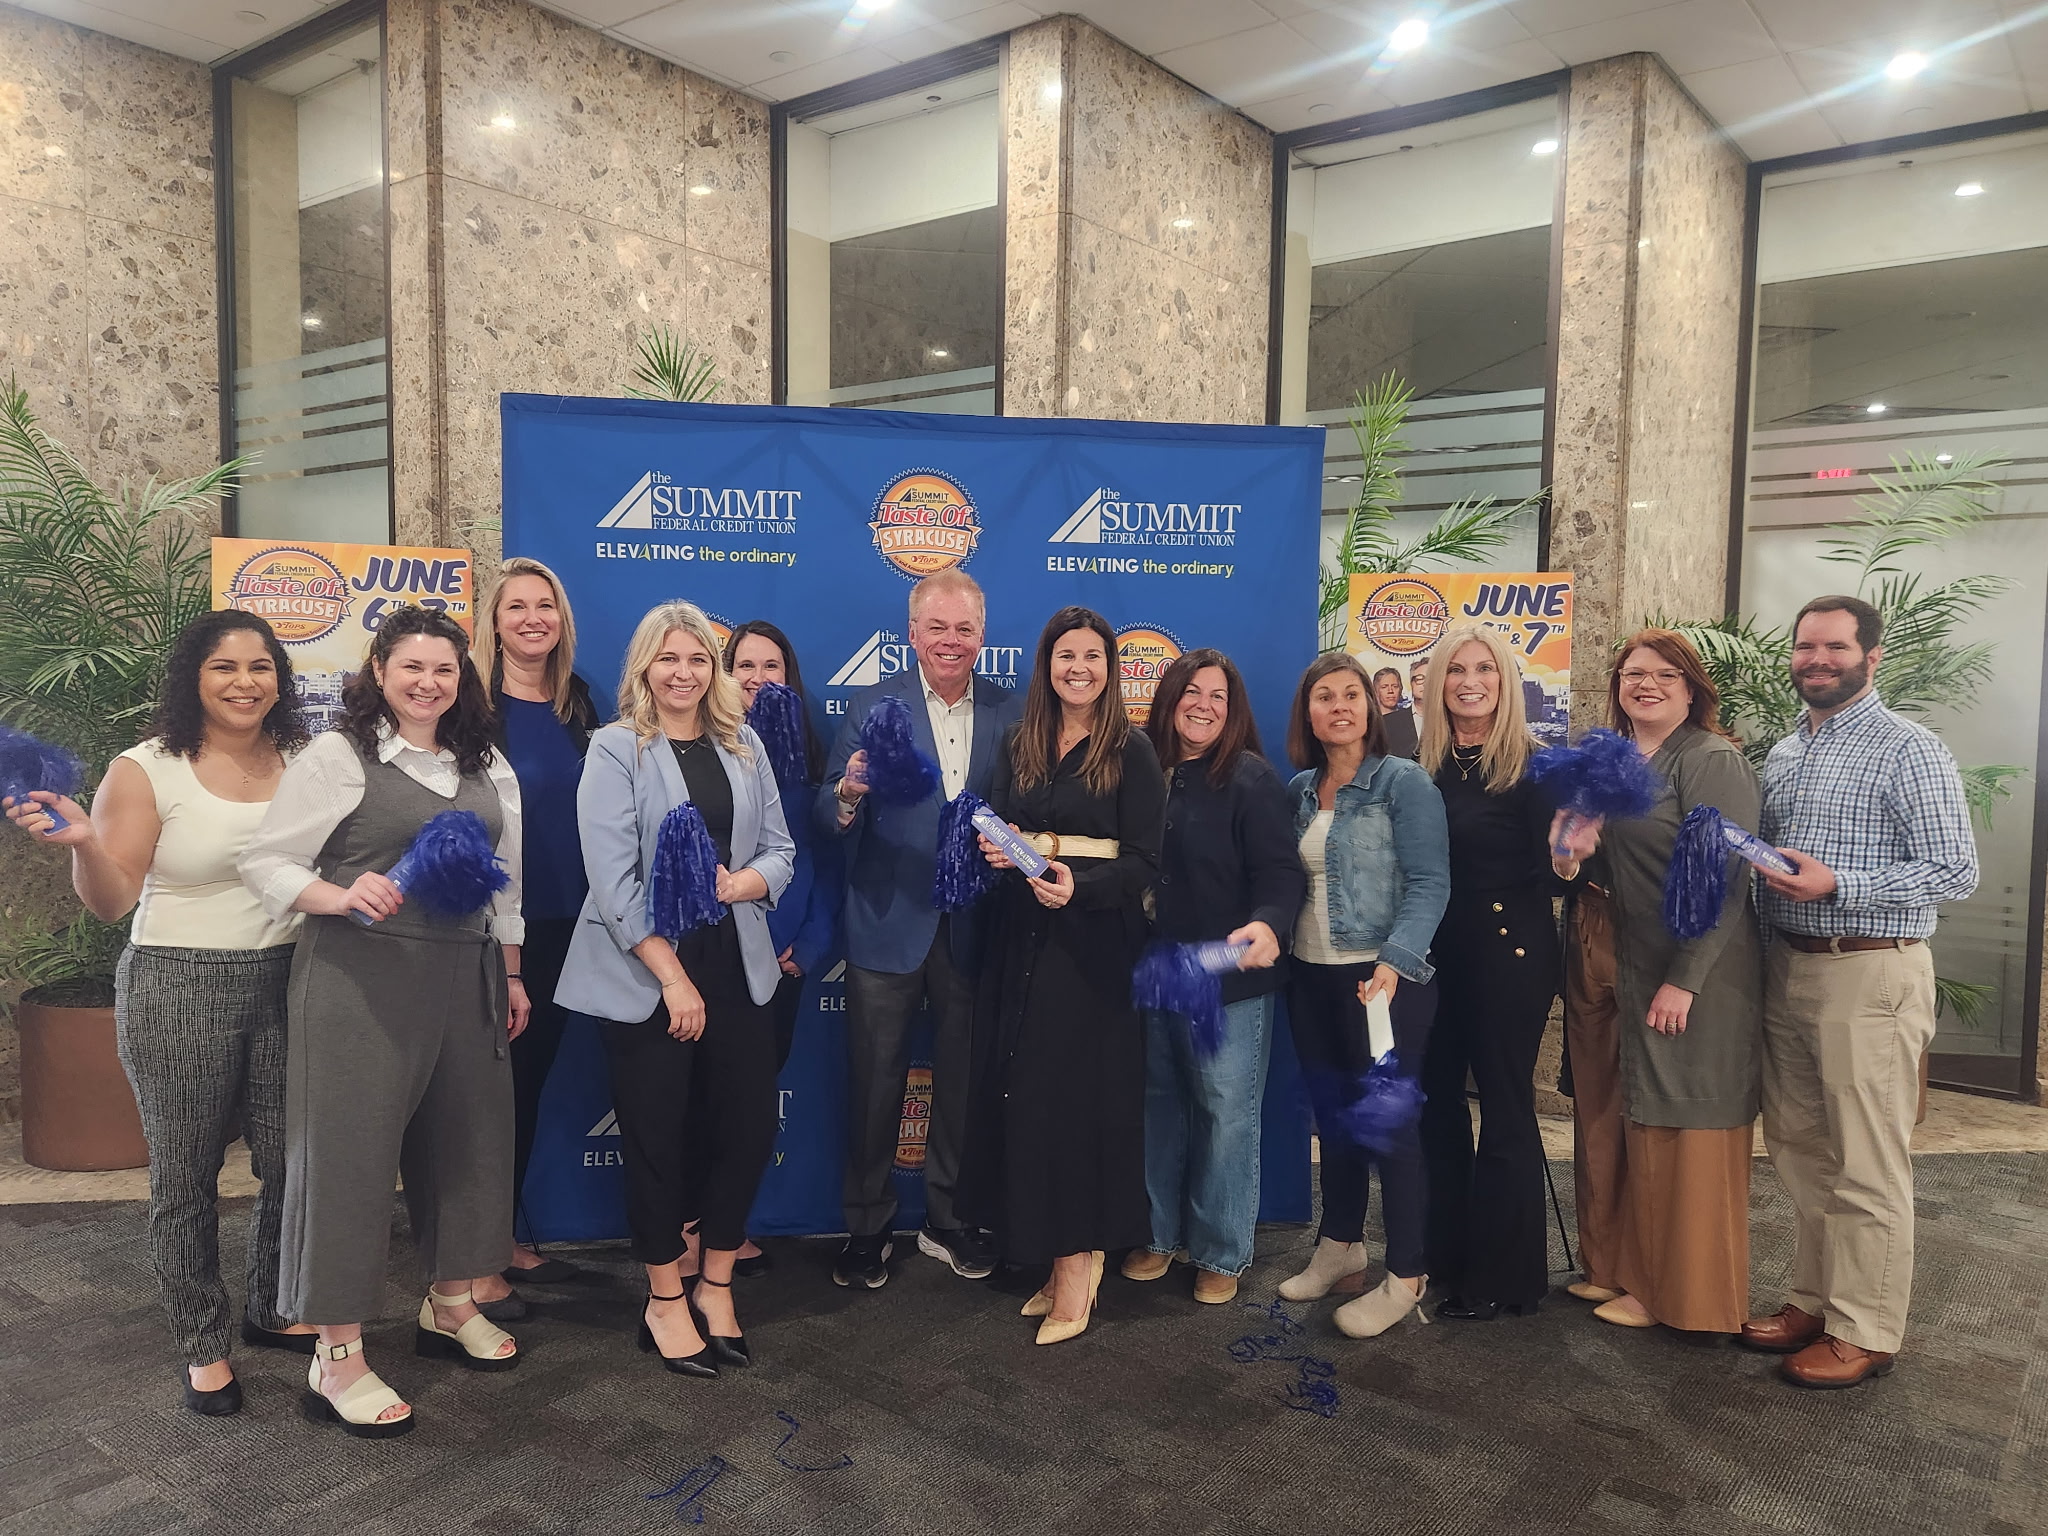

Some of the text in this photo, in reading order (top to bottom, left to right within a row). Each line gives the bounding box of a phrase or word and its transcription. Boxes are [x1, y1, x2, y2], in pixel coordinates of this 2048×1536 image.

[652, 471, 671, 484] the
[652, 485, 801, 520] SUMMIT
[912, 492, 949, 500] SUMMIT
[1102, 488, 1120, 500] the
[881, 503, 974, 527] Taste Of
[1101, 502, 1242, 533] SUMMIT
[653, 518, 796, 534] FEDERAL CREDIT UNION
[883, 529, 966, 551] SYRACUSE
[1101, 532, 1235, 546] FEDERAL CREDIT UNION
[596, 542, 694, 561] ELEVATING
[699, 546, 725, 561] the
[275, 565, 317, 574] SUMMIT
[1047, 557, 1139, 574] ELEVATING
[1143, 559, 1167, 574] the
[352, 556, 467, 594] JUNE
[240, 576, 344, 597] Taste Of
[241, 599, 336, 618] SYRACUSE
[1463, 584, 1570, 616] JUNE
[1369, 603, 1446, 618] Taste Of
[881, 630, 899, 642] the
[1369, 620, 1439, 635] SYRACUSE
[1510, 632, 1521, 645] &
[1129, 646, 1165, 654] SUMMIT
[983, 817, 1009, 842] SUMMIT
[1011, 842, 1038, 868] ELEVATING
